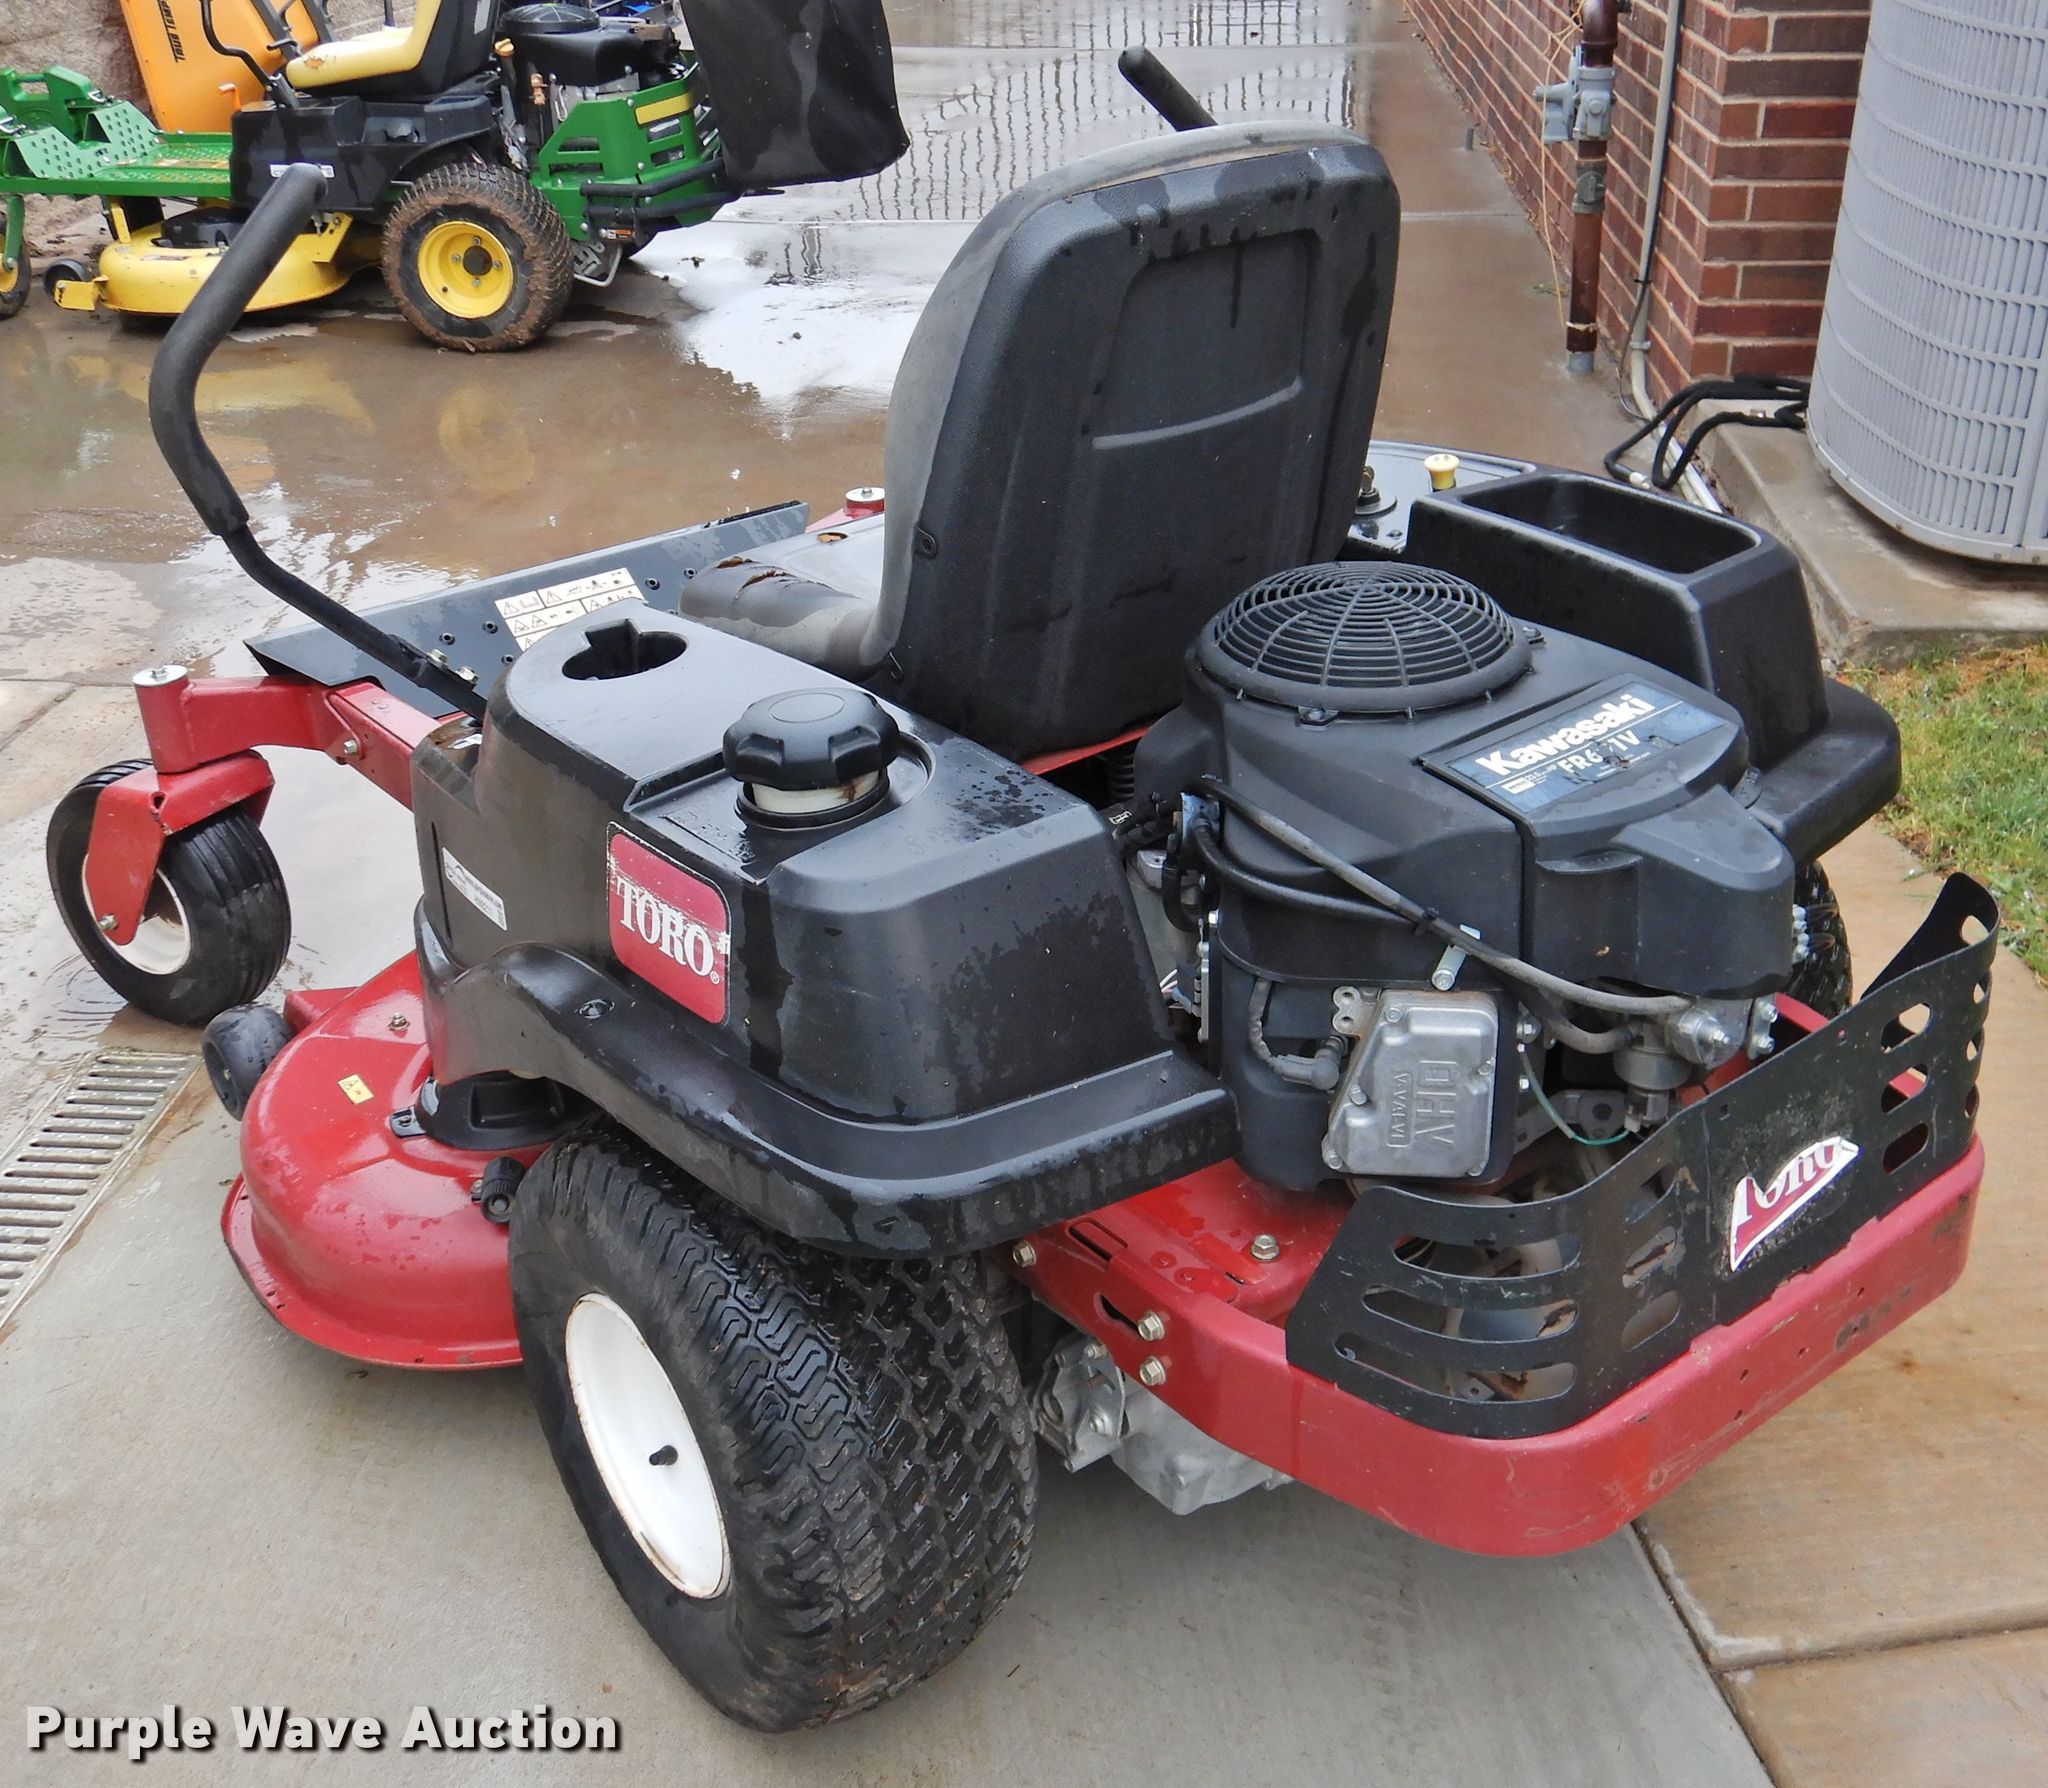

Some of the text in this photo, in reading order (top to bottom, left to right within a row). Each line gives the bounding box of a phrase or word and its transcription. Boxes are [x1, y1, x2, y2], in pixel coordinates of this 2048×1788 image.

[1474, 693, 1657, 777] Kawasaki
[1559, 728, 1641, 776] FR61V
[615, 876, 715, 977] TORO
